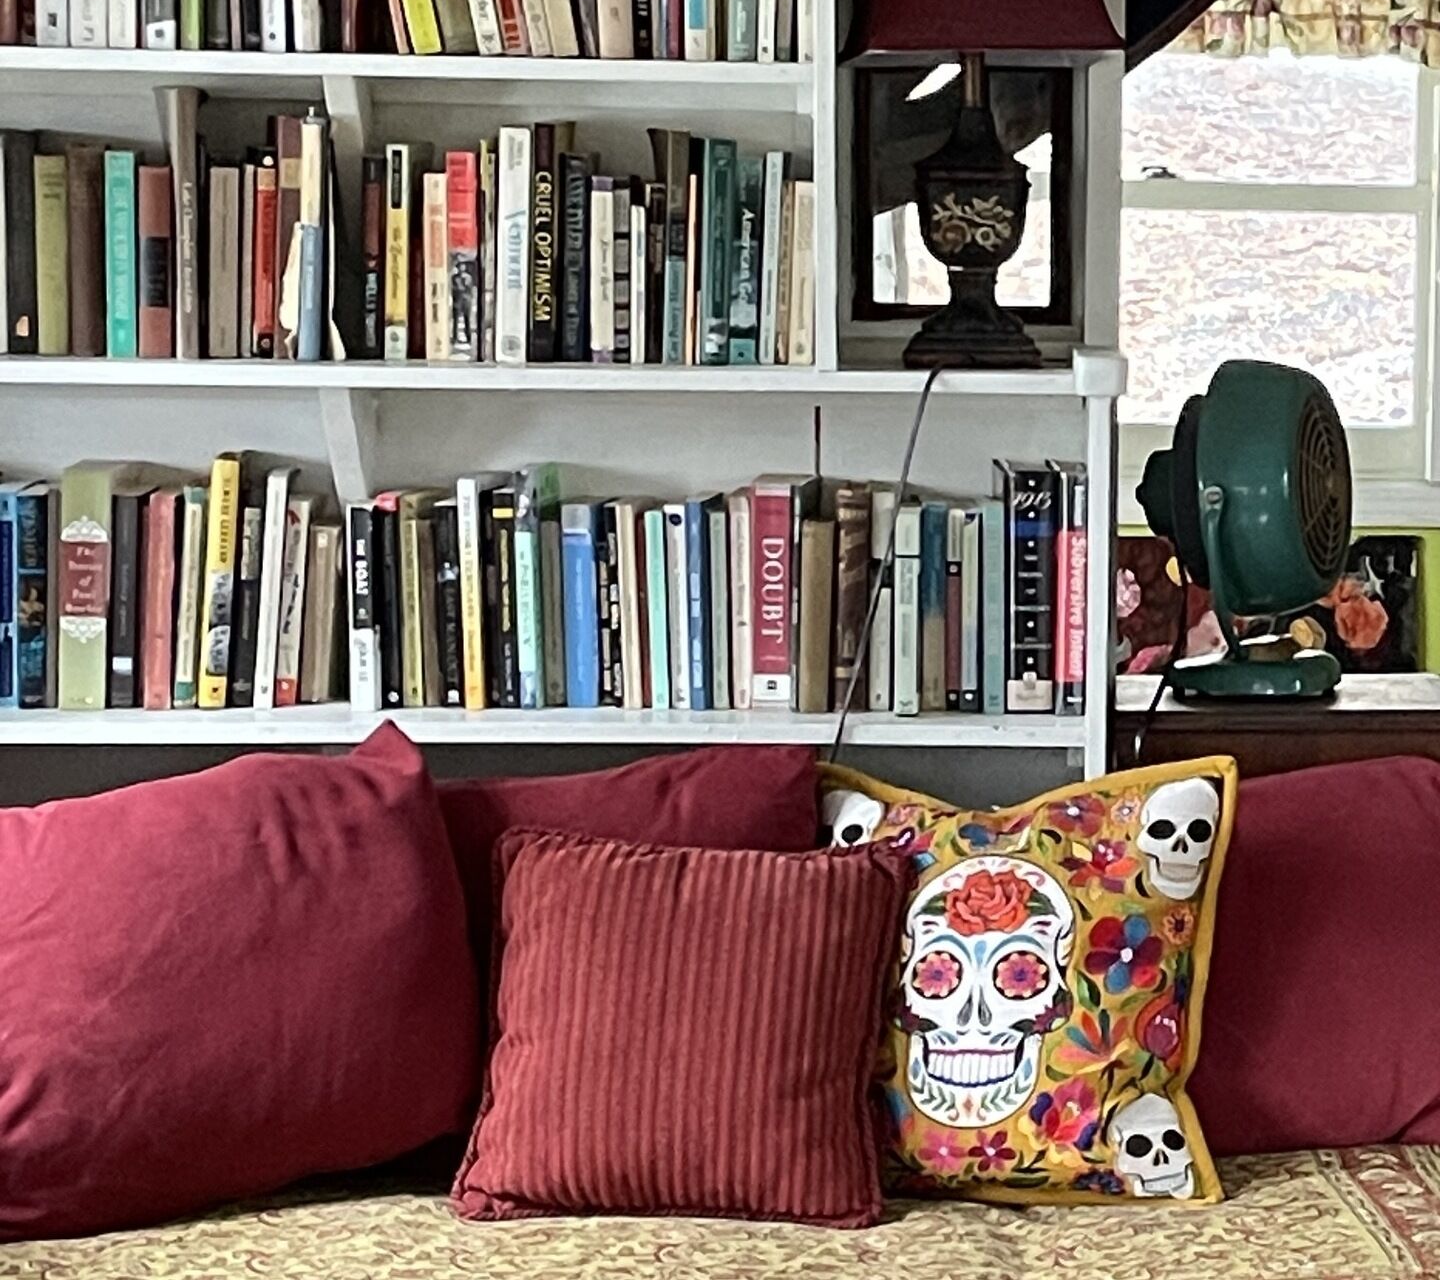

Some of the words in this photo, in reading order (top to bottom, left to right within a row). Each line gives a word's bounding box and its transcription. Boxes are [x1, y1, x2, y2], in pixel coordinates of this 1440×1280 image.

[535, 171, 552, 223] CRUEL
[504, 209, 526, 290] Vermont
[534, 228, 552, 320] OPTIMISM
[740, 208, 754, 279] American
[1012, 491, 1052, 509] 1913
[355, 560, 368, 595] BOAT
[761, 538, 785, 644] DOUBT
[1069, 535, 1086, 625] Subversive
[1068, 628, 1083, 677] Intent
